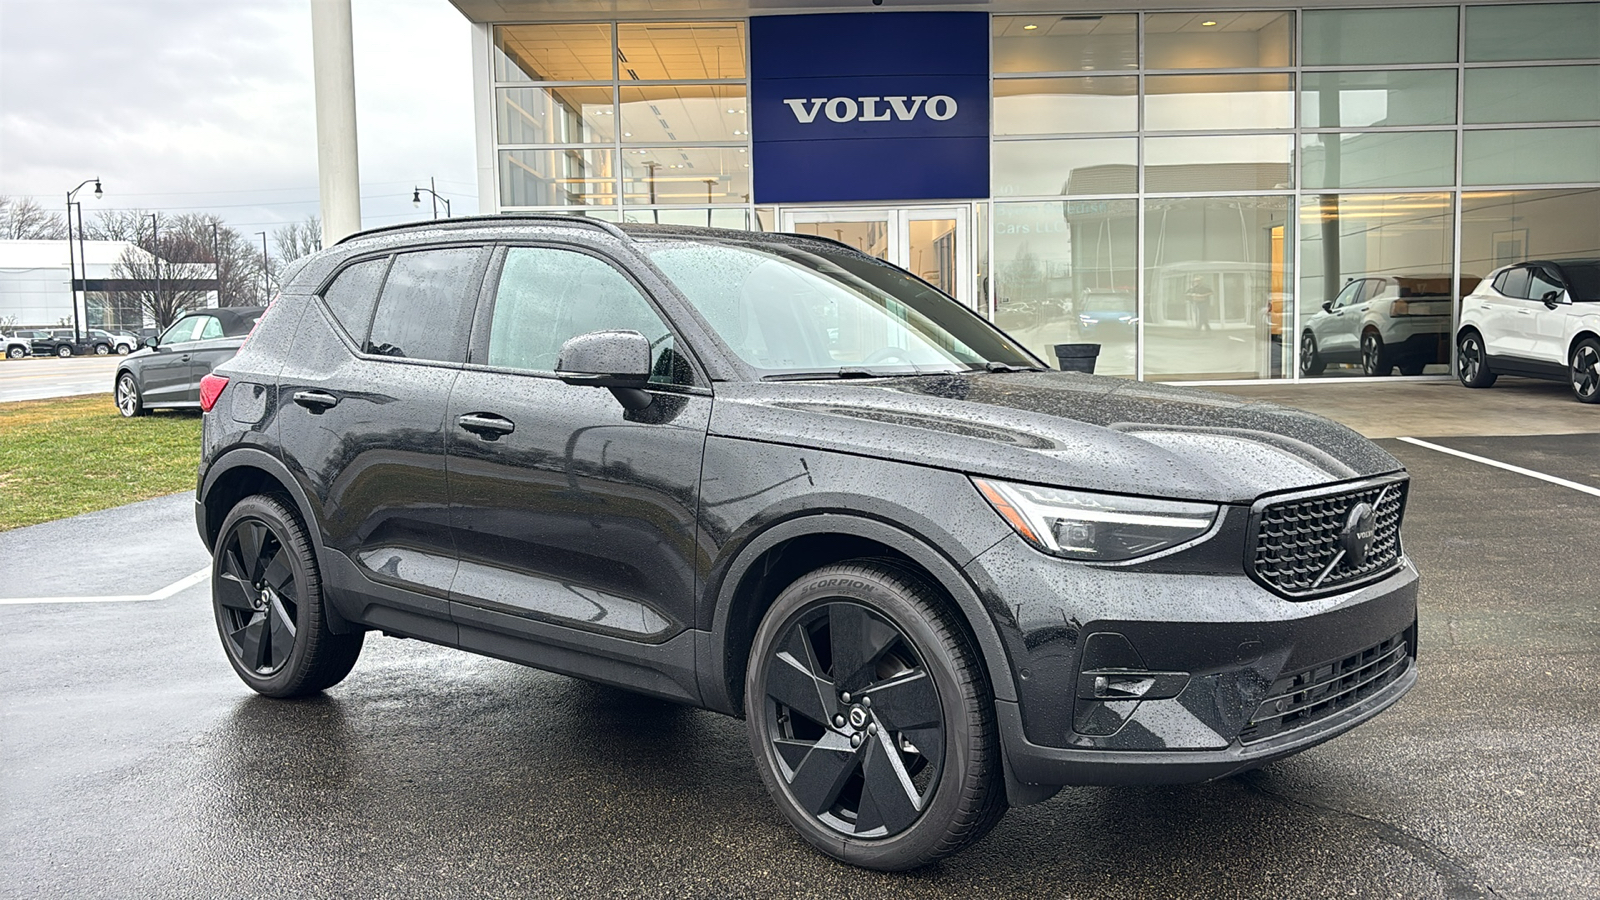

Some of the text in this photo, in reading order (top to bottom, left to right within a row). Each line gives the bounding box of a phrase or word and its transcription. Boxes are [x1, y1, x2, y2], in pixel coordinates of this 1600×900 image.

[783, 95, 957, 123] VOLVO
[996, 220, 1066, 234] Cars LLC
[1356, 531, 1374, 539] VOLV
[801, 578, 875, 595] SCORPION
